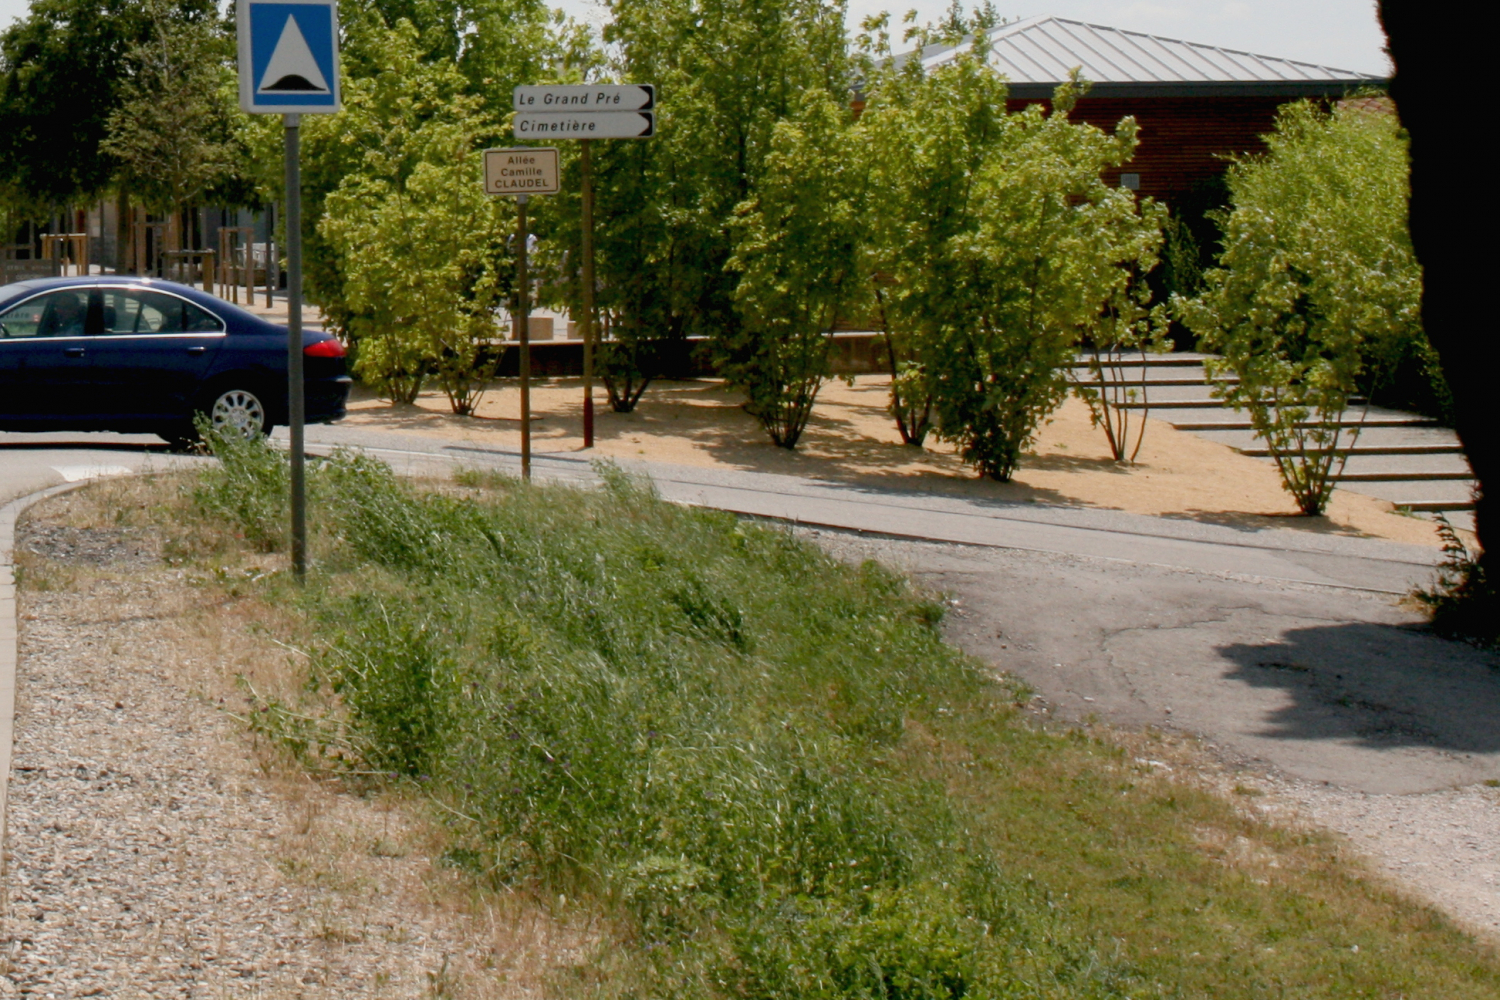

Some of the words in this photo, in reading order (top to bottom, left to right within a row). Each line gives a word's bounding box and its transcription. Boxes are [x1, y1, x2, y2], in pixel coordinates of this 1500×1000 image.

[519, 93, 535, 106] Le
[543, 92, 590, 105] Grand
[595, 91, 621, 104] Pré
[519, 119, 596, 132] Cimetière
[507, 156, 535, 165] Allée
[501, 168, 543, 176] Camille
[494, 179, 549, 188] CLAUDEL
